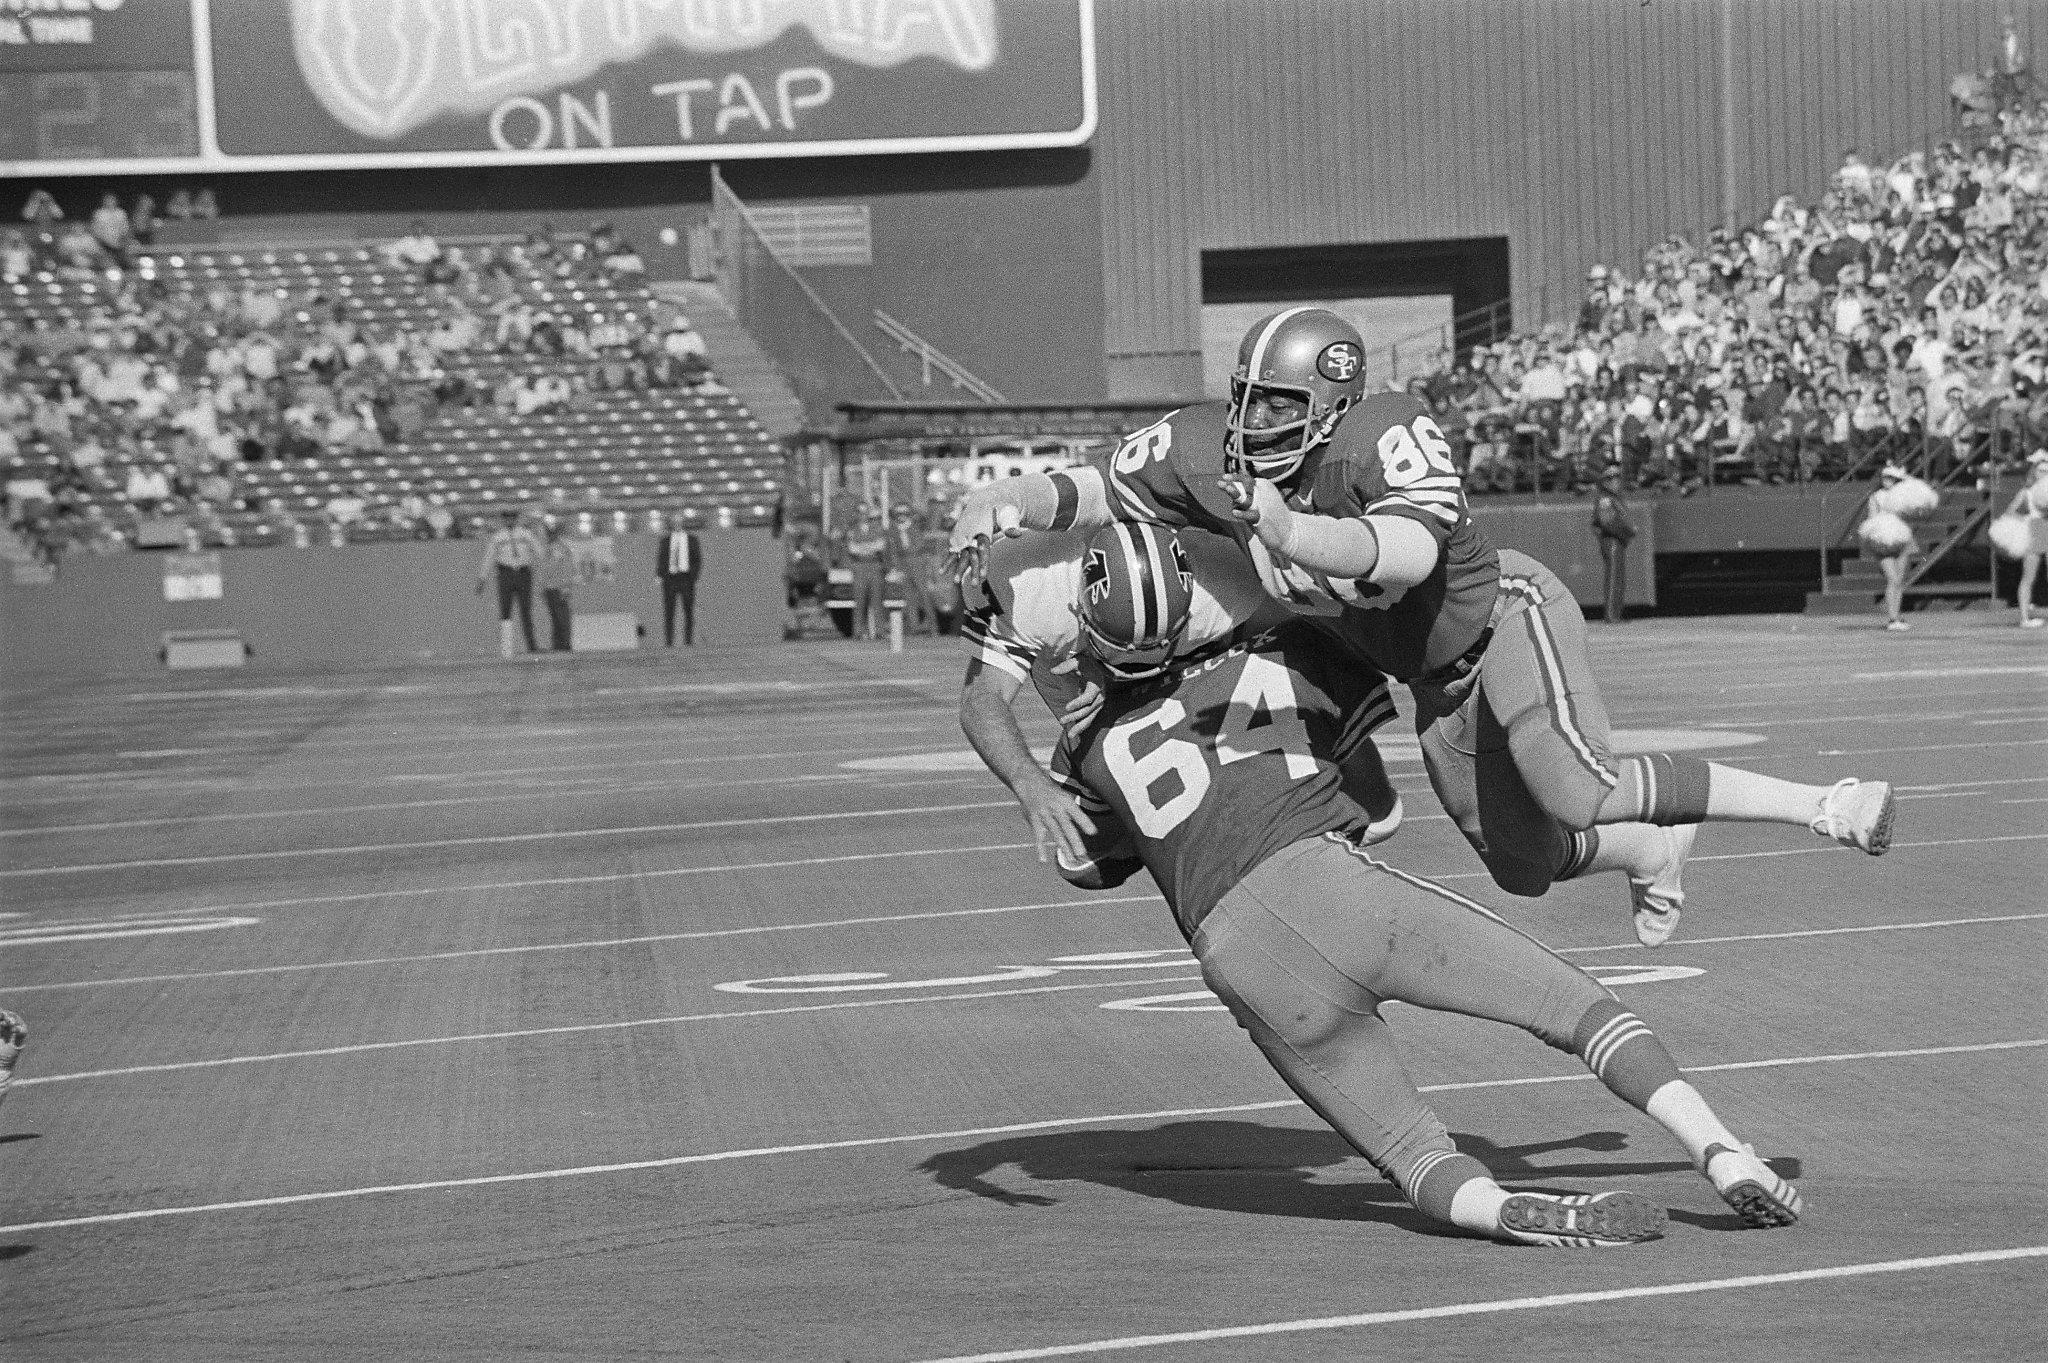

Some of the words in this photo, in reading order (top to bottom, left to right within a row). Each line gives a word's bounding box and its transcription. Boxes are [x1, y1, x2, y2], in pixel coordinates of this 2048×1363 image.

[490, 91, 613, 150] ON
[651, 67, 834, 139] TAP
[1328, 344, 1357, 380] SF
[1377, 415, 1456, 487] 86
[1103, 652, 1320, 839] 64
